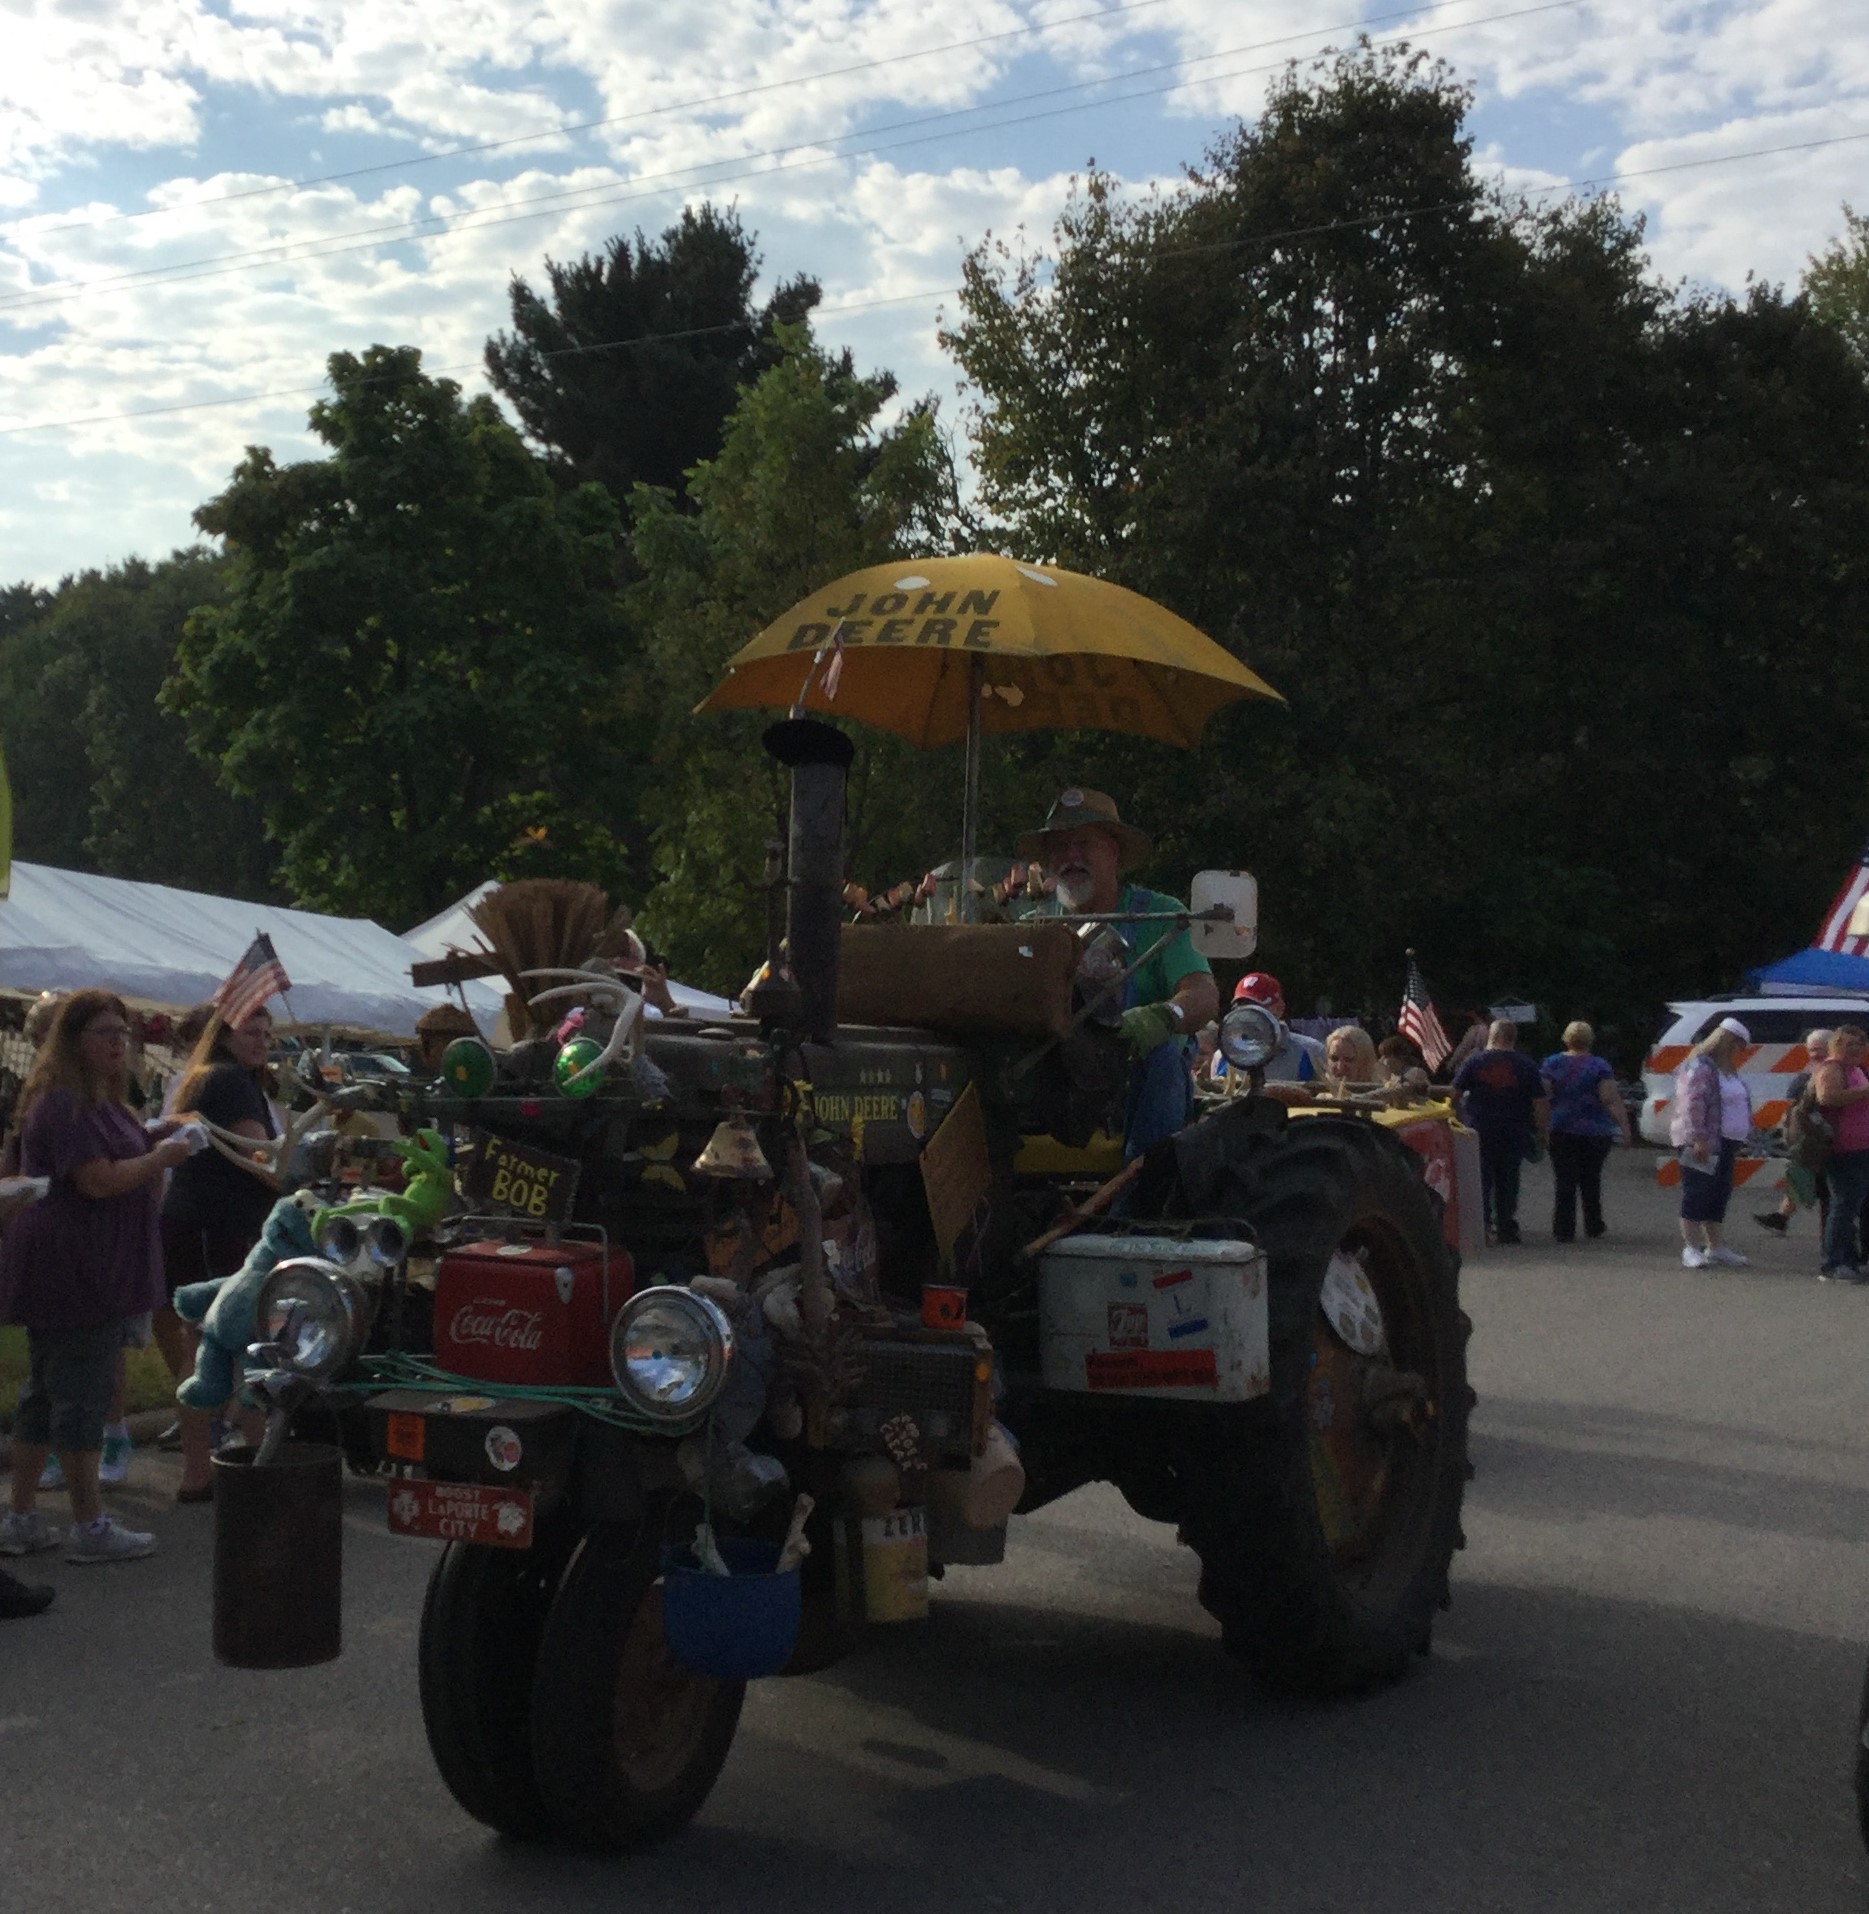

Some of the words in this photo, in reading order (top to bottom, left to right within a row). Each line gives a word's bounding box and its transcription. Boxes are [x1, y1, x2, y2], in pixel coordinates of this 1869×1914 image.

[827, 590, 1000, 617] JOHN
[787, 618, 1000, 650] DEERE
[814, 1095, 850, 1121] JOHN
[854, 1095, 898, 1121] DEERE
[485, 1136, 560, 1187] Farmer
[492, 1168, 549, 1216] BOB
[428, 1498, 489, 1520] LaPORTE
[438, 1517, 480, 1538] CITY
